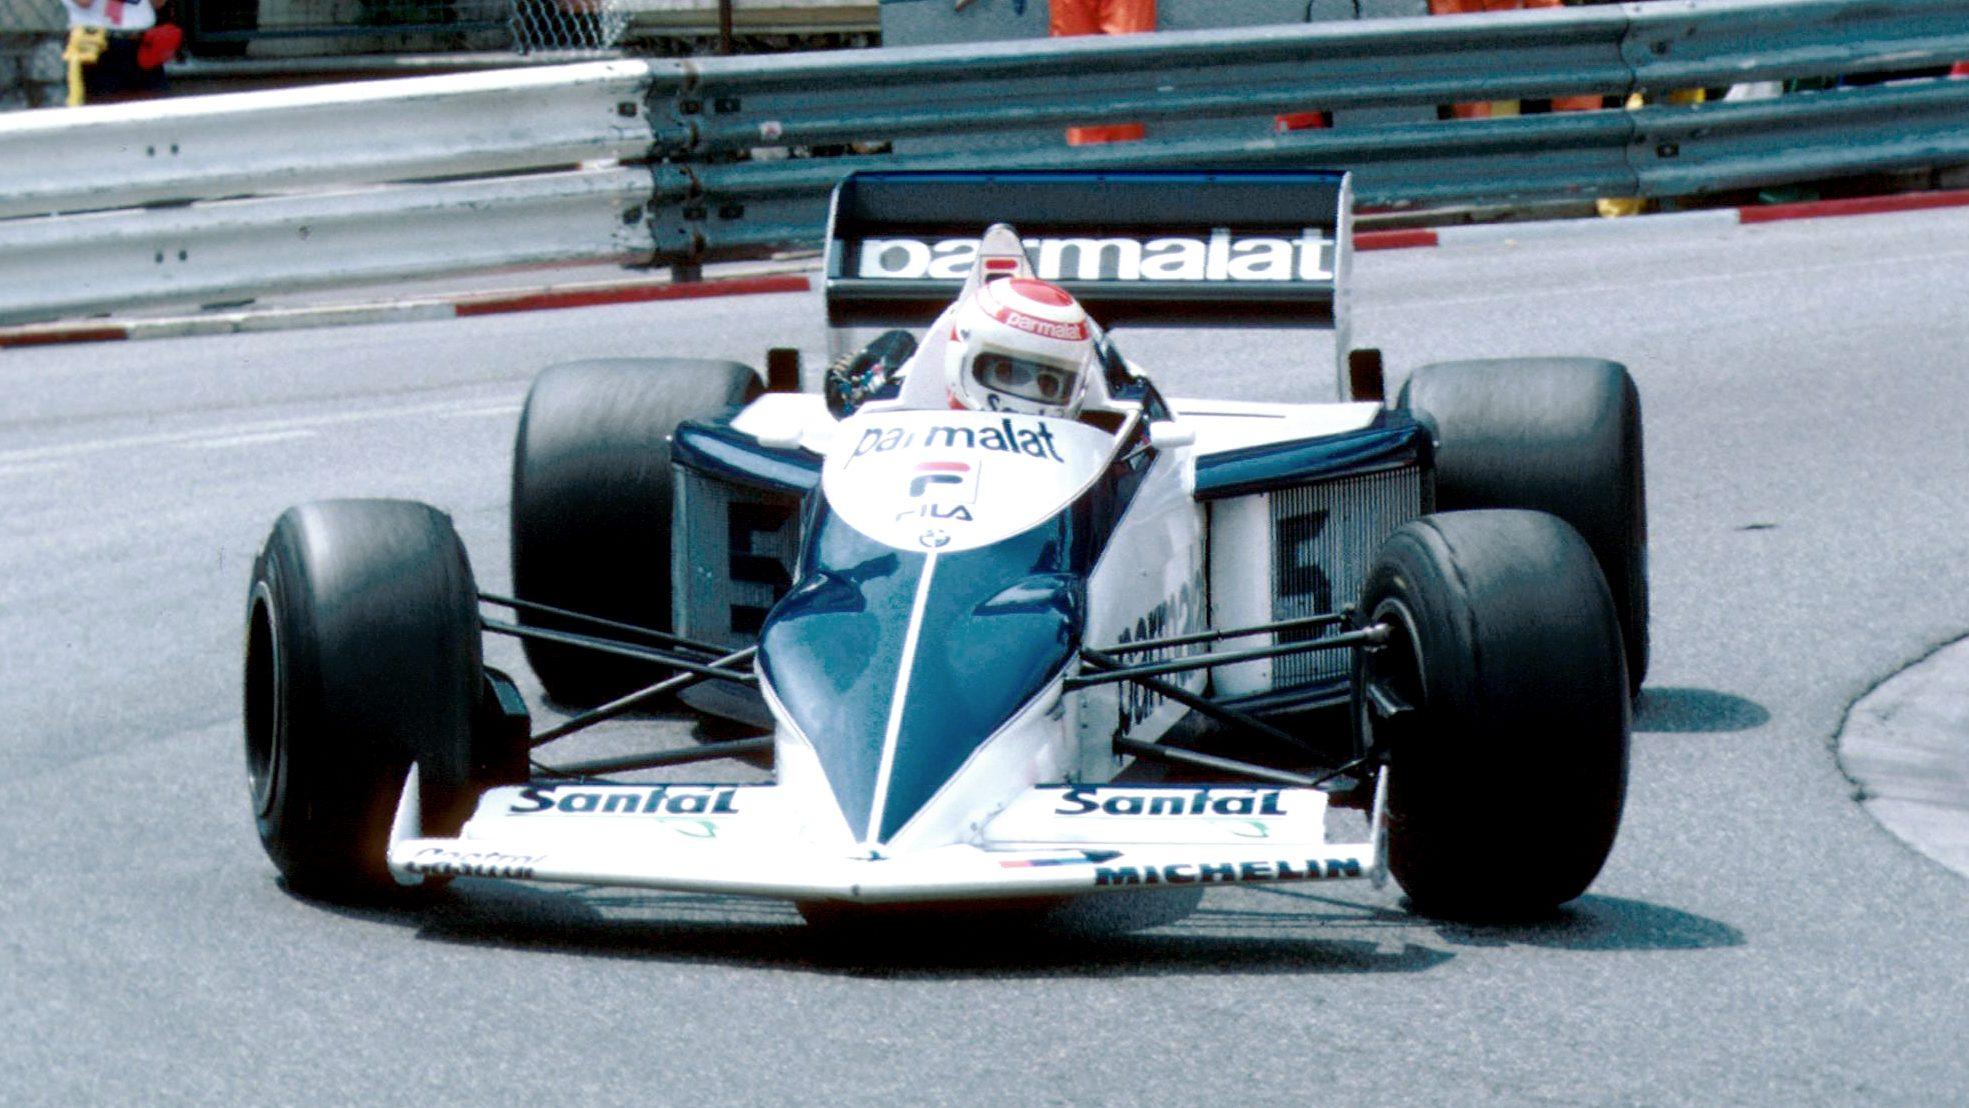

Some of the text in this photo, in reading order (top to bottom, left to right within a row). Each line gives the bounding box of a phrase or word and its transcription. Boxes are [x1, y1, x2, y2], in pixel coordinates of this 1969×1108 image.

[858, 228, 1334, 281] pamalat
[1007, 311, 1080, 340] parmalat
[844, 418, 1064, 470] parmalat
[509, 785, 739, 814] Santal
[1055, 785, 1288, 815] Santal
[1095, 857, 1361, 886] MICHELIN
